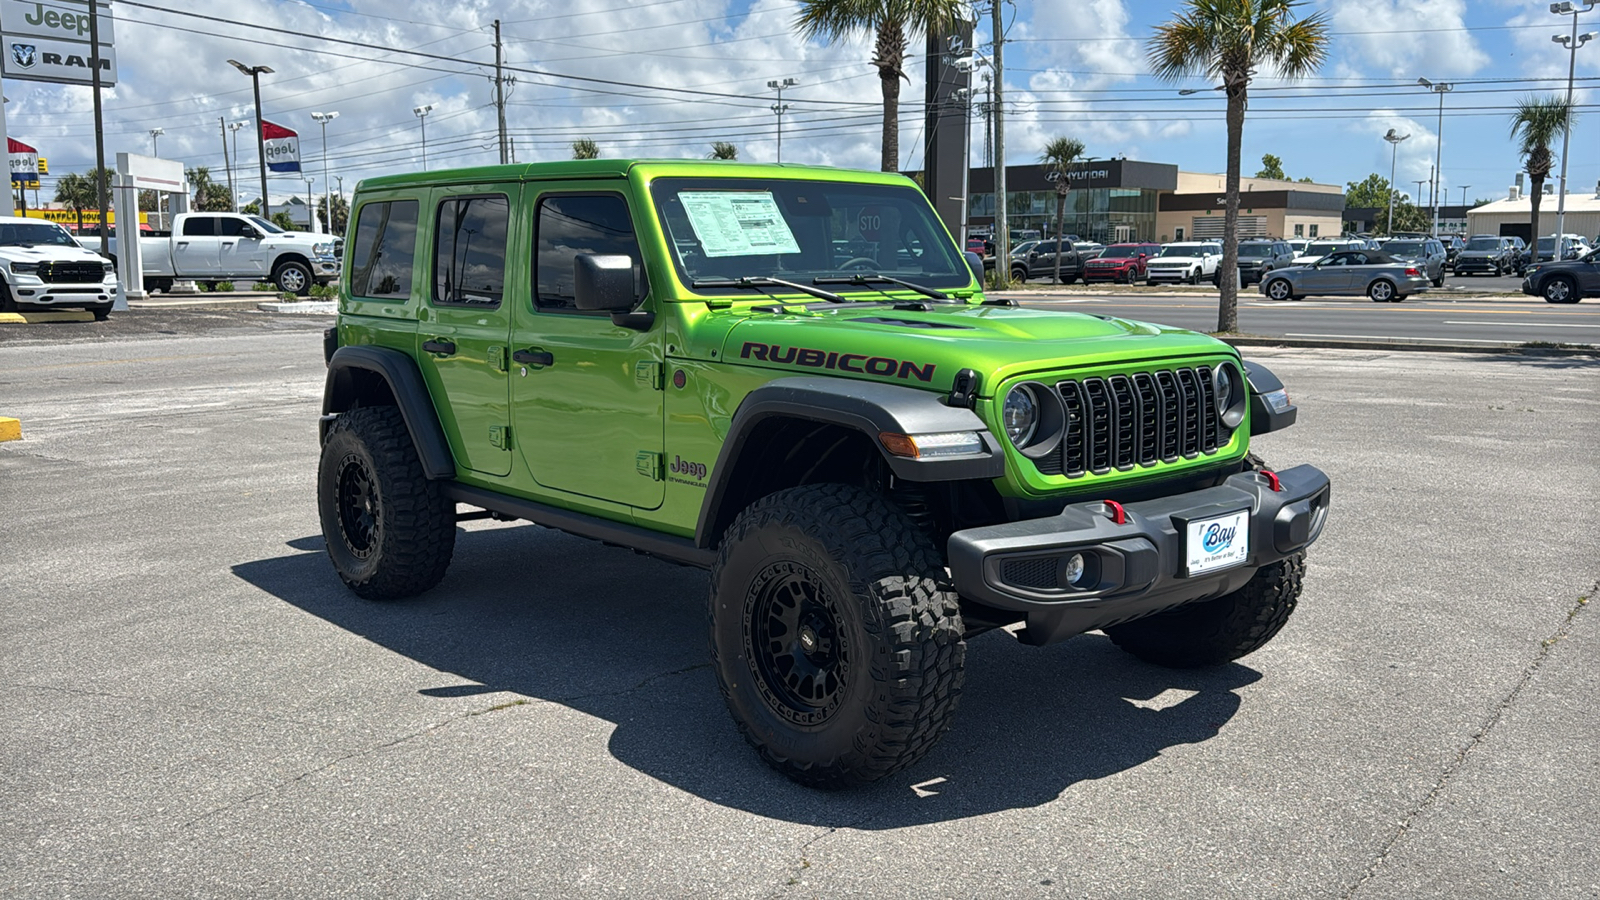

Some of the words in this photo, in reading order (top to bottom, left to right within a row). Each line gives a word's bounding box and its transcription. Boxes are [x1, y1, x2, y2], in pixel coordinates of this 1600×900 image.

[25, 3, 90, 36] Jeep
[42, 52, 111, 70] RAM
[860, 215, 880, 231] STO
[740, 342, 936, 382] RUBICON
[670, 455, 707, 480] Jeep
[1206, 523, 1236, 548] Bay
